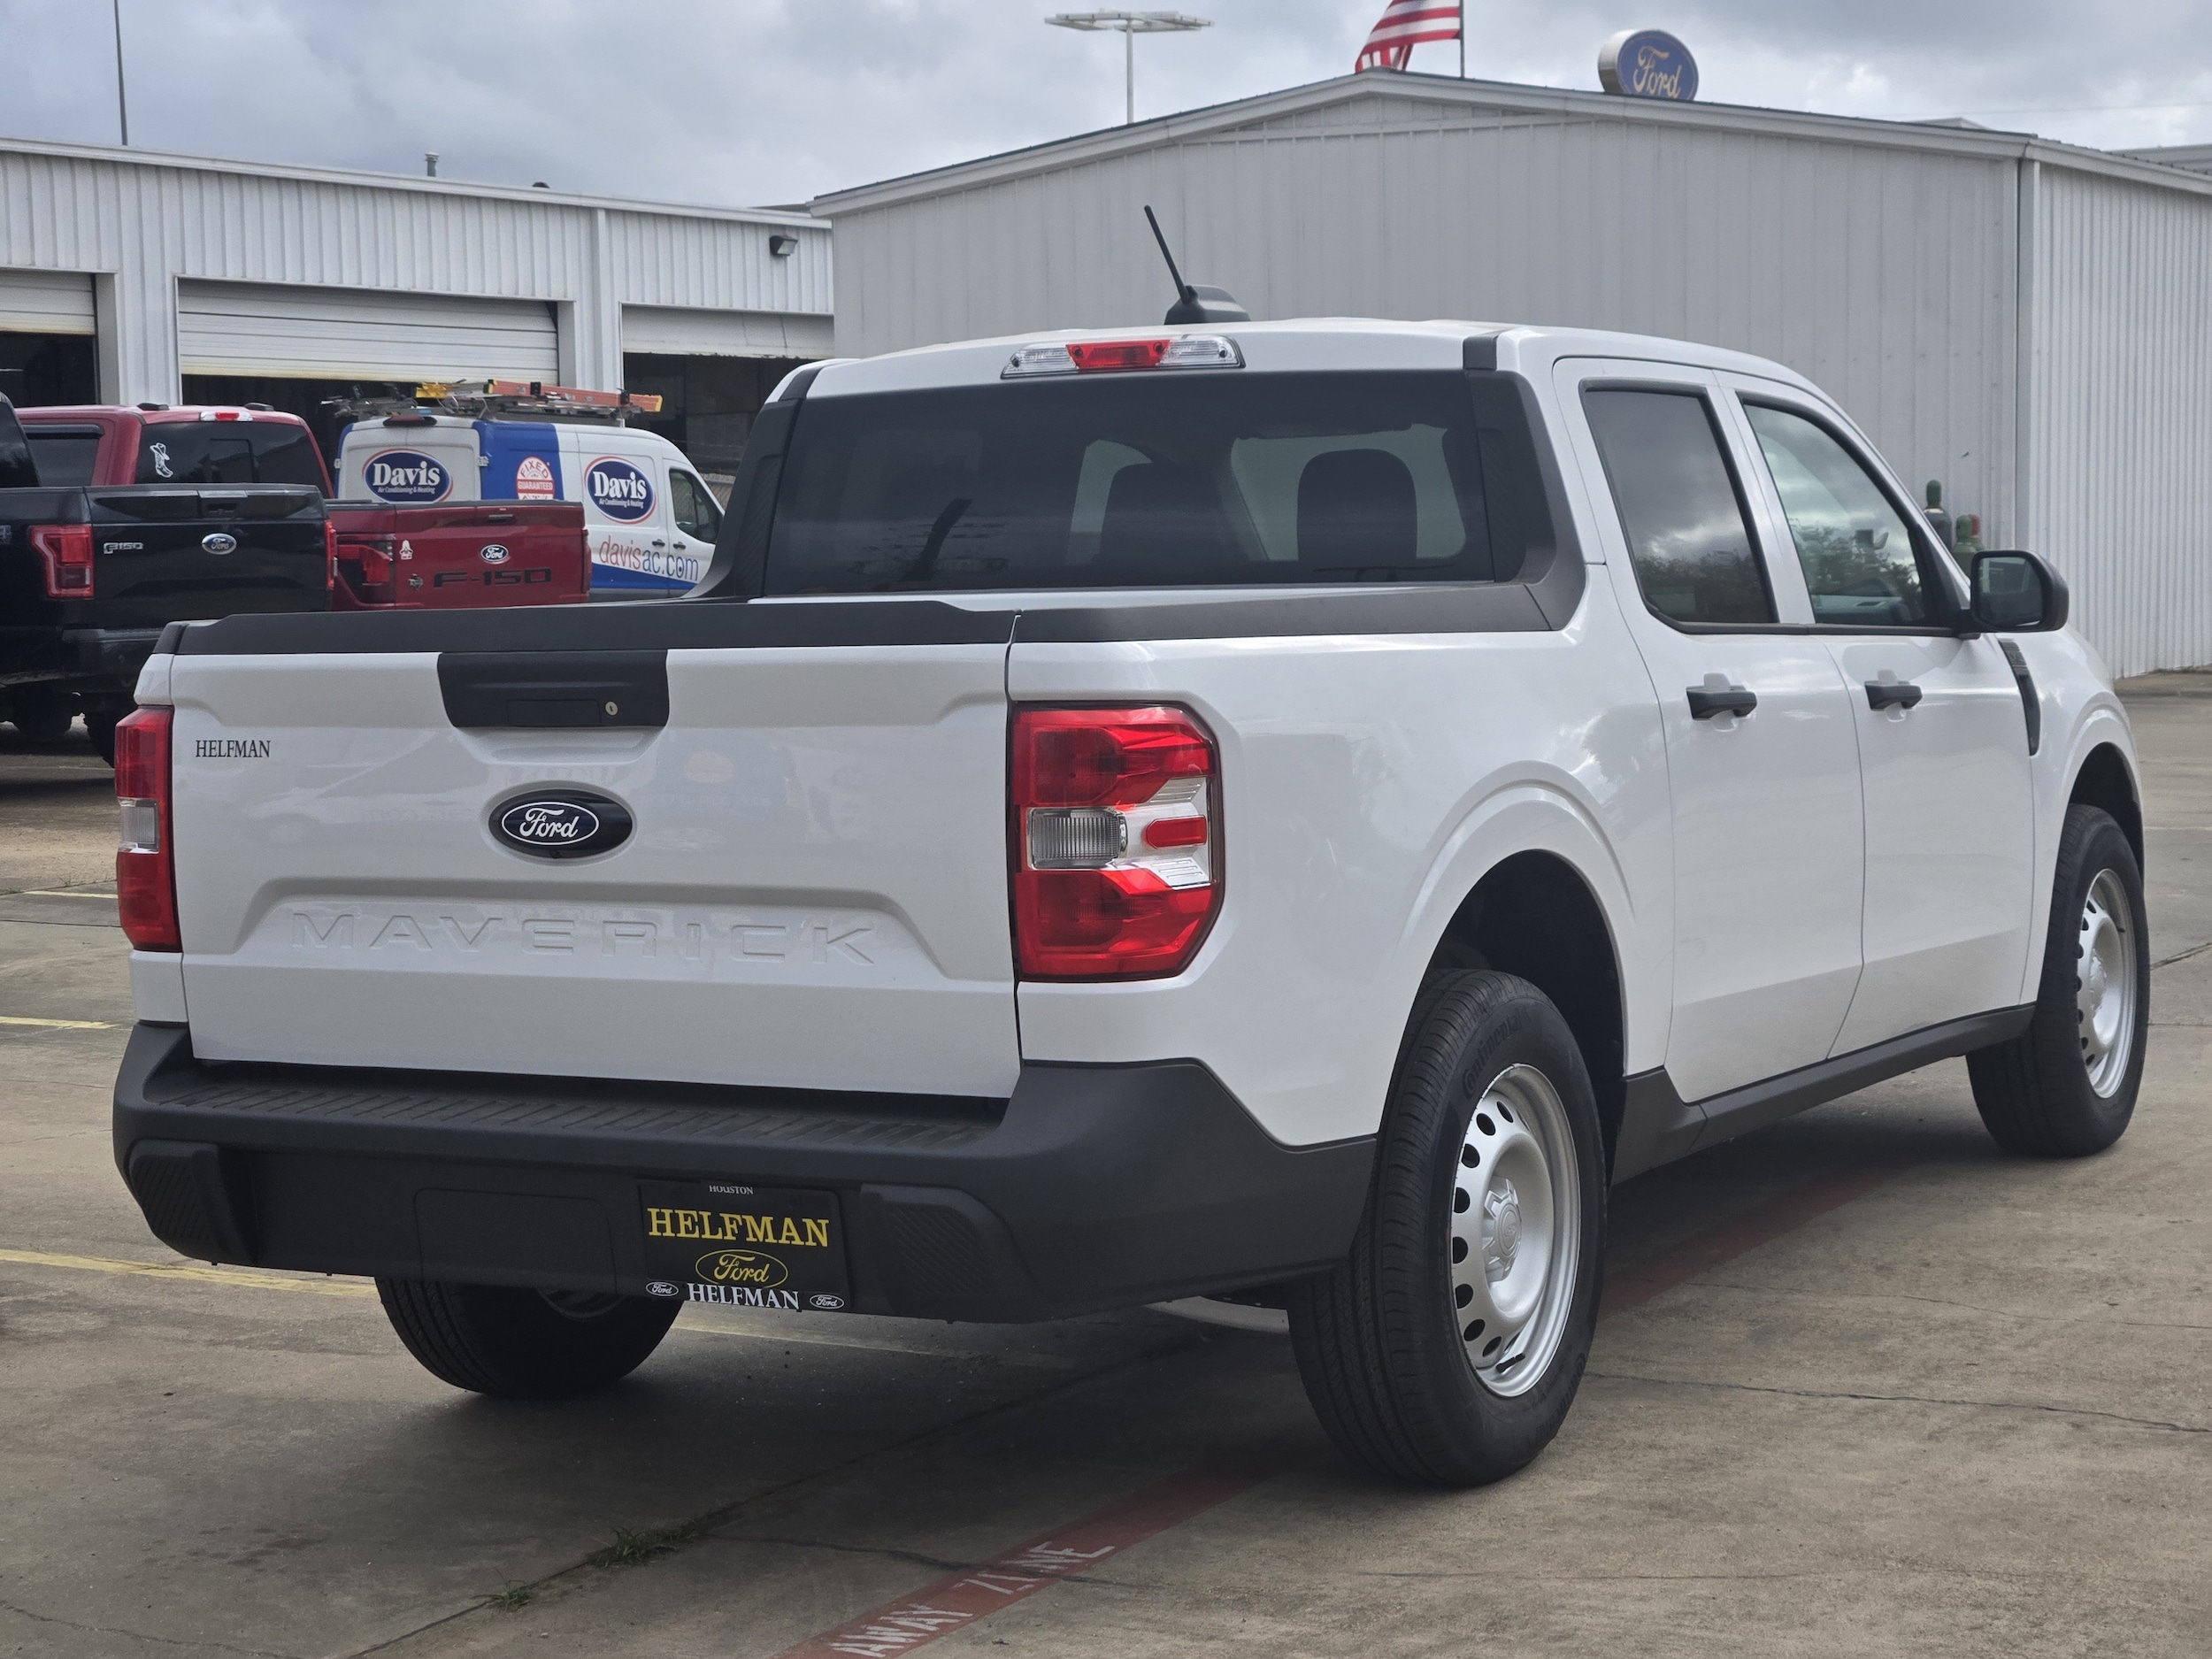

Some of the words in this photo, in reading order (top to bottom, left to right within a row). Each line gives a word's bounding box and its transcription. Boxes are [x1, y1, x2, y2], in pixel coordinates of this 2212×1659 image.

[1632, 45, 1683, 99] Ford
[373, 460, 441, 486] Davis
[519, 460, 549, 479] FIXED
[593, 472, 647, 498] Davis
[486, 547, 504, 559] Ford
[599, 535, 699, 581] davisac.com
[433, 567, 552, 588] F-150
[196, 740, 271, 758] HELFMAN
[519, 807, 580, 838] Ford
[292, 912, 877, 966] MAVERICK
[709, 1185, 754, 1195] HOUSTON
[647, 1207, 830, 1248] HELFMAN
[714, 1253, 771, 1283] Ford
[651, 1284, 672, 1295] Ford
[687, 1283, 800, 1310] HELFMAN
[816, 1296, 838, 1308] Ford
